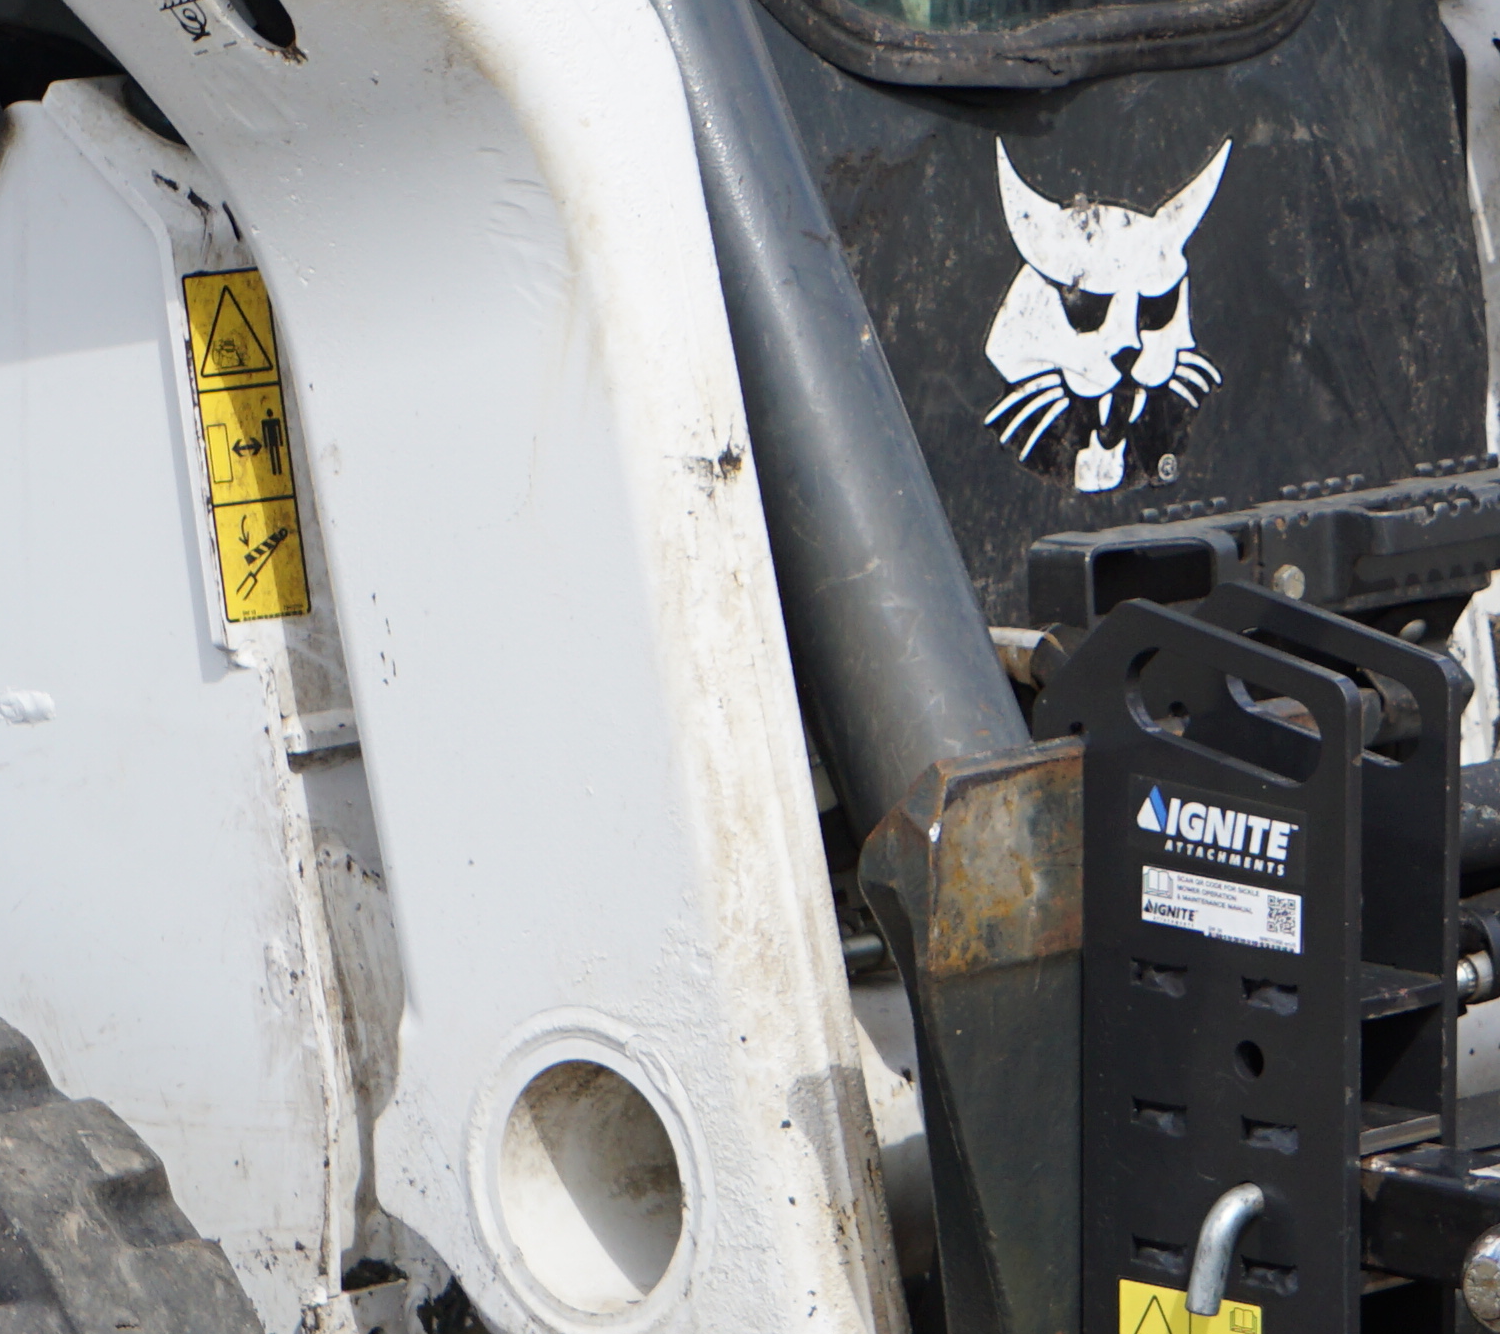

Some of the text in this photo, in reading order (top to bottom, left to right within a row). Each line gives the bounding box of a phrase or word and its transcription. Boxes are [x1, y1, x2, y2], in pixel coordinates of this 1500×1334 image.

[1165, 839, 1285, 876] ATTACHMENTS
[1177, 875, 1260, 897] SCAN QR CODE FOR SICKLE
[1177, 884, 1237, 902] MOWER OPERATION
[1182, 895, 1227, 909] MAINTENANCE
[1227, 903, 1253, 915] MANUAL
